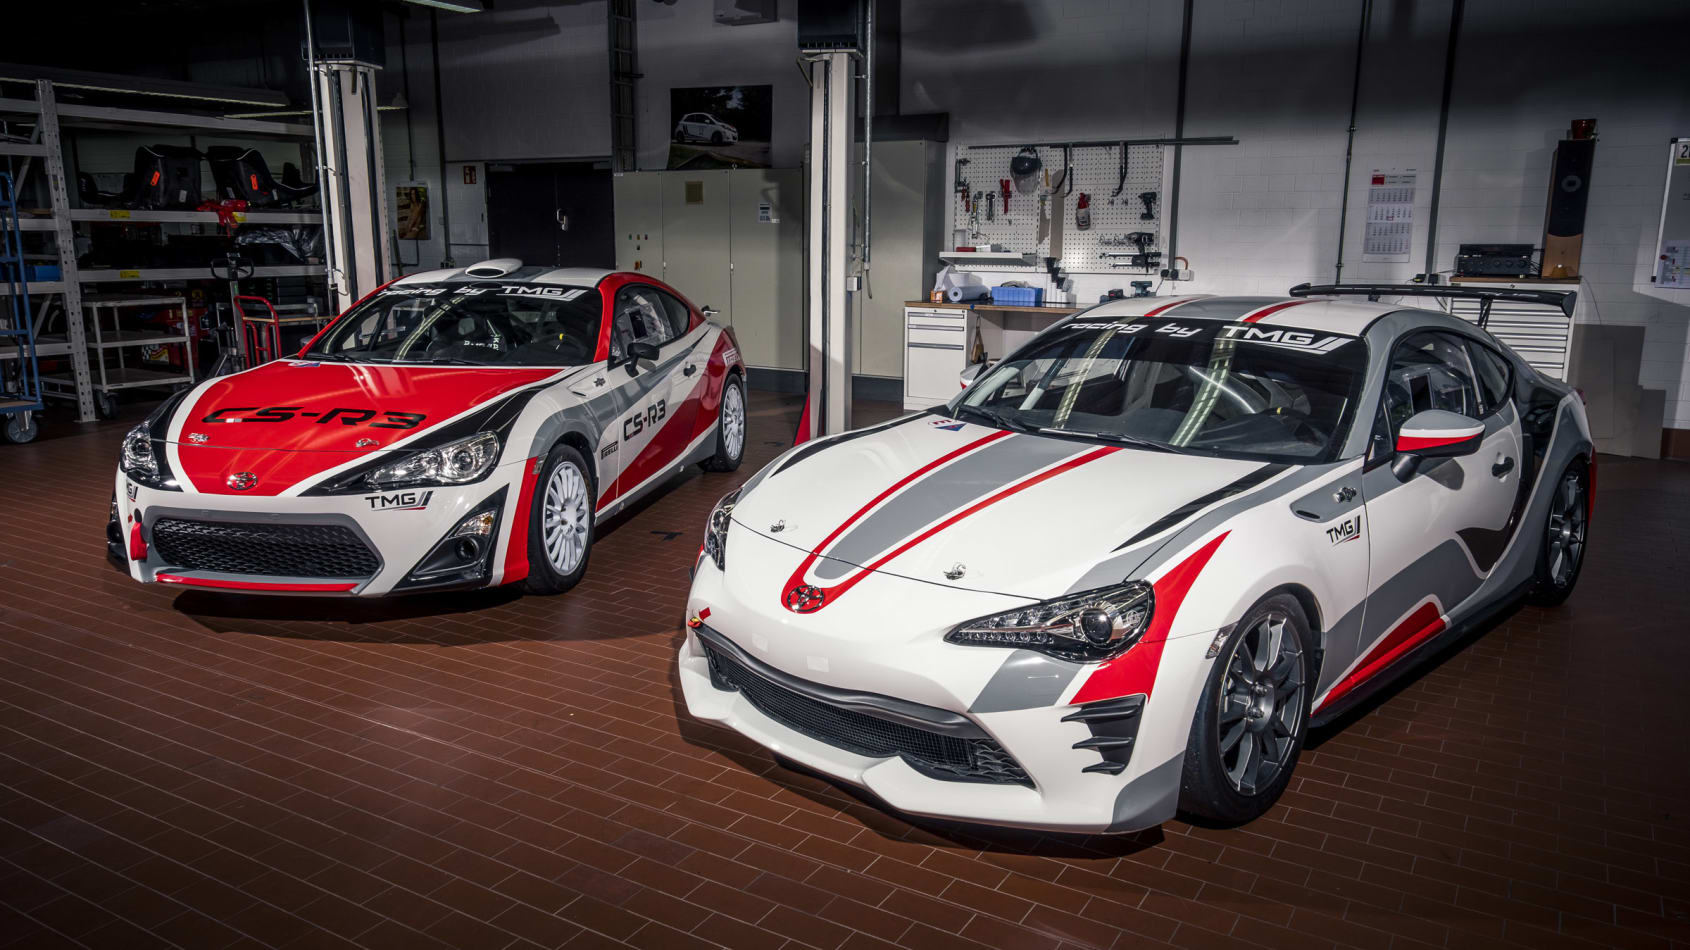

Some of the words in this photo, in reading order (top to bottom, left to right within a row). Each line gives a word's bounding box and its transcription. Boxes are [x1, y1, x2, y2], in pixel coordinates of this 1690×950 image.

[453, 286, 489, 296] by
[500, 286, 569, 298] TMG
[1061, 320, 1149, 335] racing
[1155, 322, 1203, 338] by
[1220, 325, 1322, 347] TMG
[201, 406, 427, 430] CS-R3
[623, 398, 666, 441] CS-R3
[364, 491, 420, 510] TMG
[1325, 518, 1356, 544] TMG
